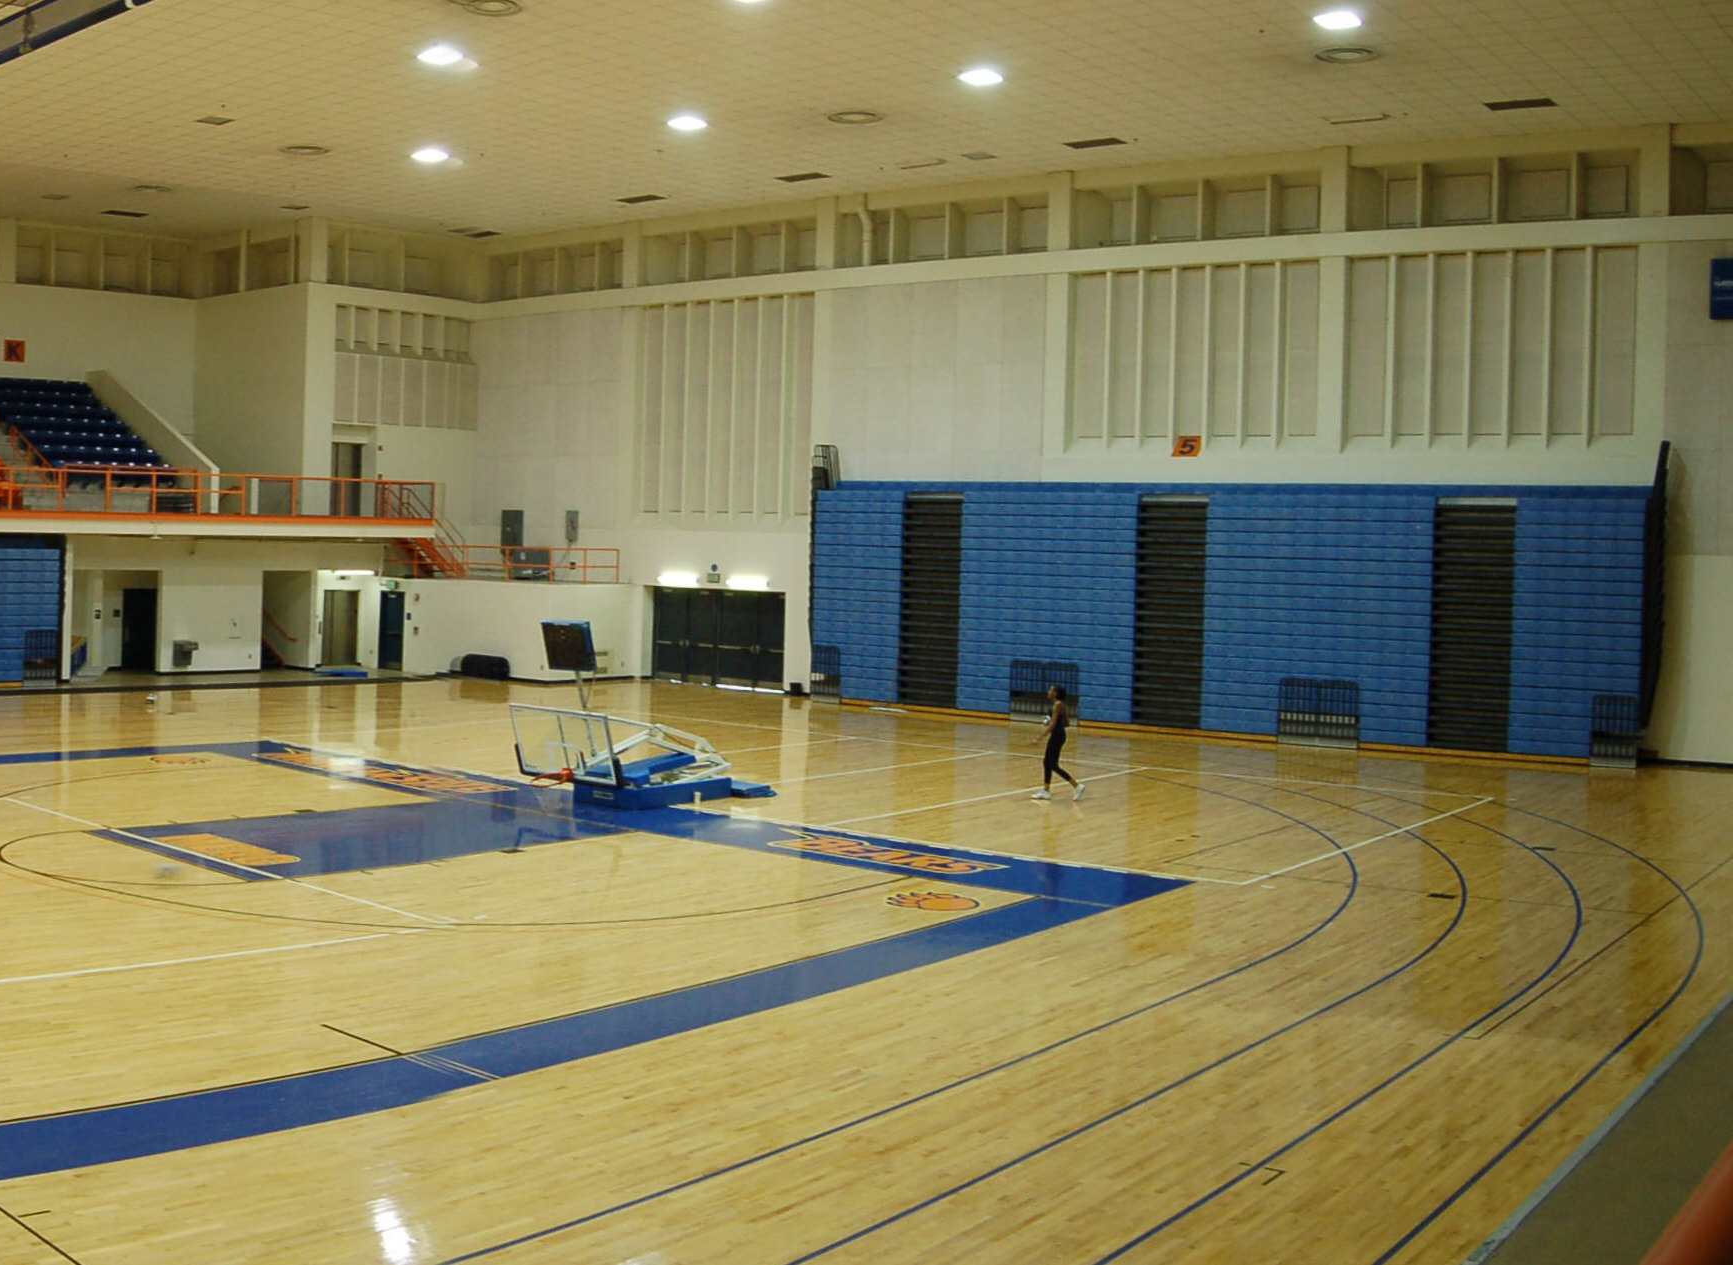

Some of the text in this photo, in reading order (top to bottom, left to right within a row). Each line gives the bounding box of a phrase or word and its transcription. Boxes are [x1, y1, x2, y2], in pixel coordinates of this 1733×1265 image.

[8, 343, 22, 360] K
[1179, 439, 1198, 454] 5
[779, 836, 997, 873] BEARS
